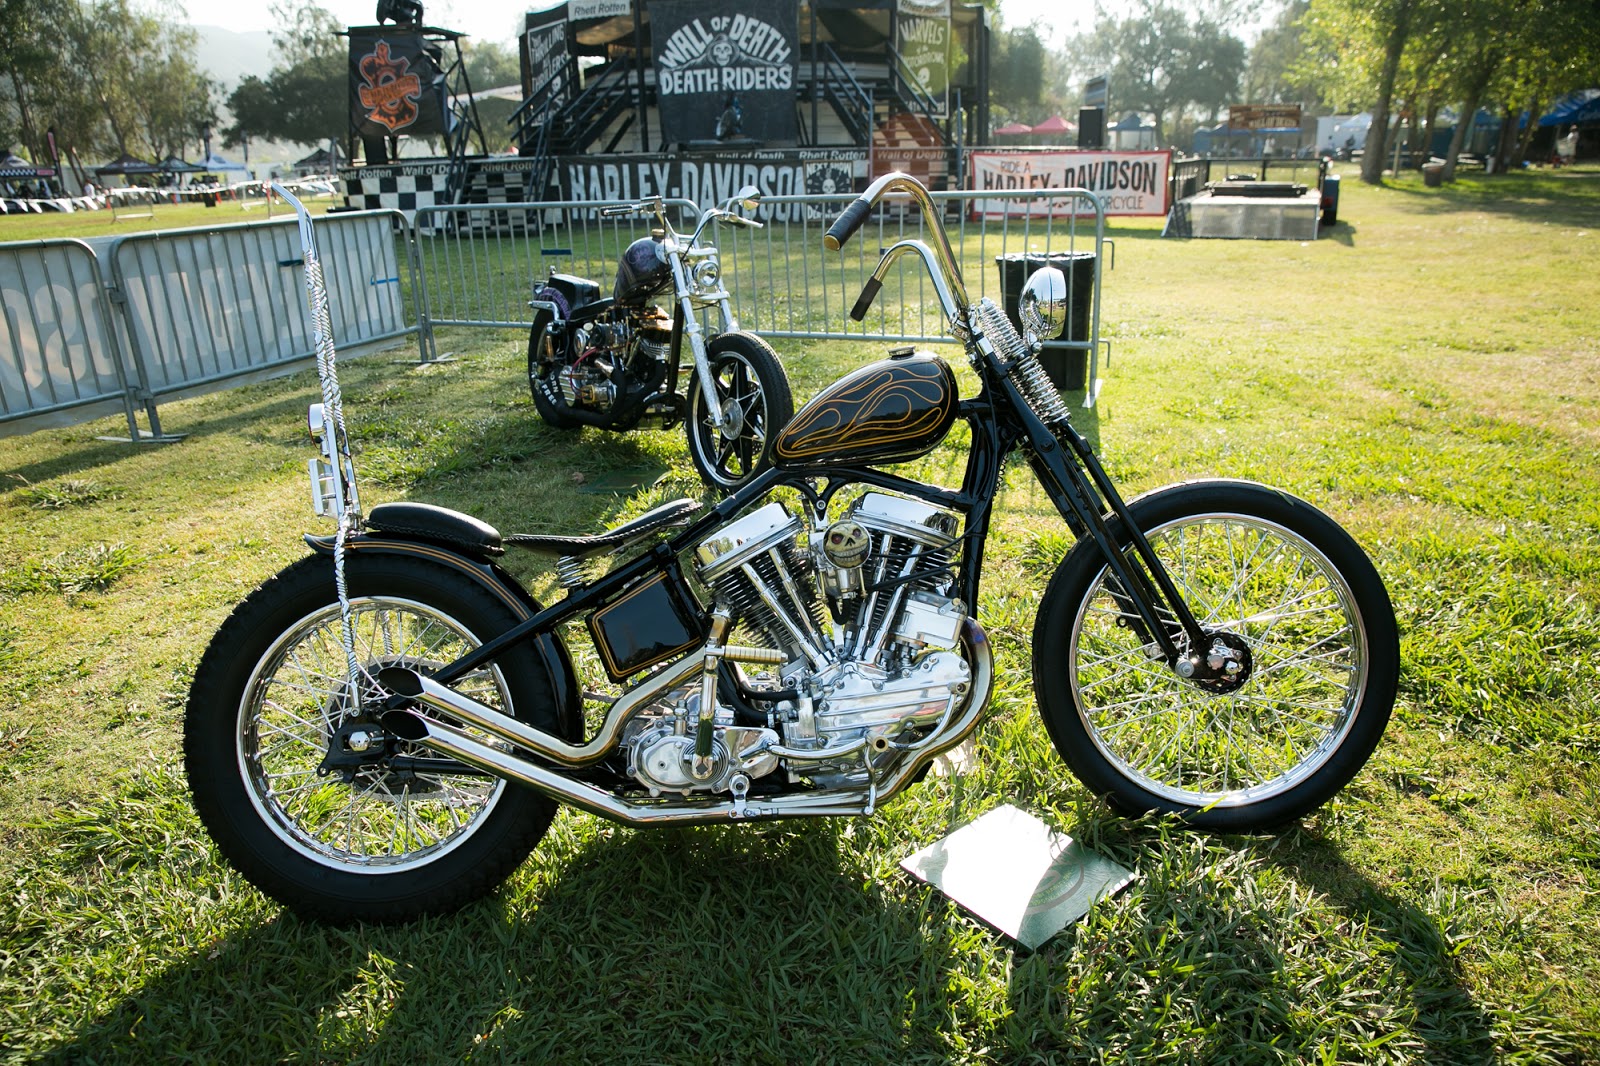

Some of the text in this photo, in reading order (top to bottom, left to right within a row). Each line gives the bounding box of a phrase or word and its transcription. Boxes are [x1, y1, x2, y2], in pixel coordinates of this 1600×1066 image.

[574, 3, 626, 16] Rhett Rotten
[658, 13, 792, 68] WALL OF DEATH
[660, 65, 793, 95] DEATH RIDERS
[799, 151, 829, 160] Rhett
[877, 151, 900, 159] Wall
[903, 150, 914, 159] of
[916, 150, 949, 160] Death
[359, 167, 393, 178] Rotten
[402, 165, 424, 176] Wall
[426, 165, 437, 175] of
[480, 161, 509, 173] Rhett
[806, 162, 828, 179] NEXT
[1001, 160, 1031, 173] RIDE A
[1078, 195, 1144, 210] MOORCYCLE
[541, 383, 557, 406] FREE
